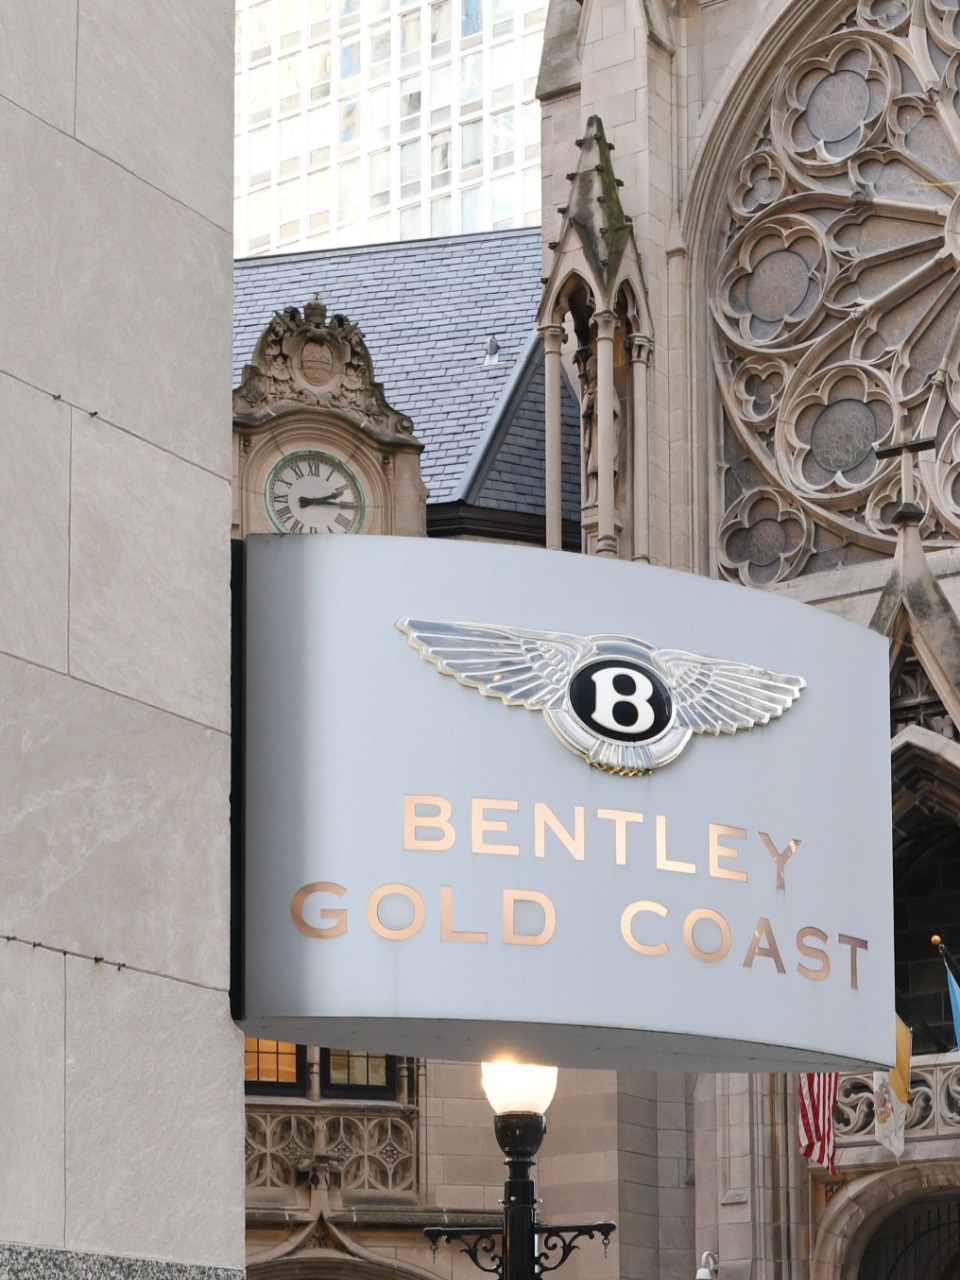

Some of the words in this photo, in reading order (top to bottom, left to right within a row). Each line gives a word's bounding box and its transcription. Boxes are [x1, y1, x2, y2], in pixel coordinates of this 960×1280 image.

[590, 666, 656, 735] B
[402, 793, 802, 890] BENTLEY
[290, 880, 556, 946] GOLD
[620, 898, 869, 990] COAST
